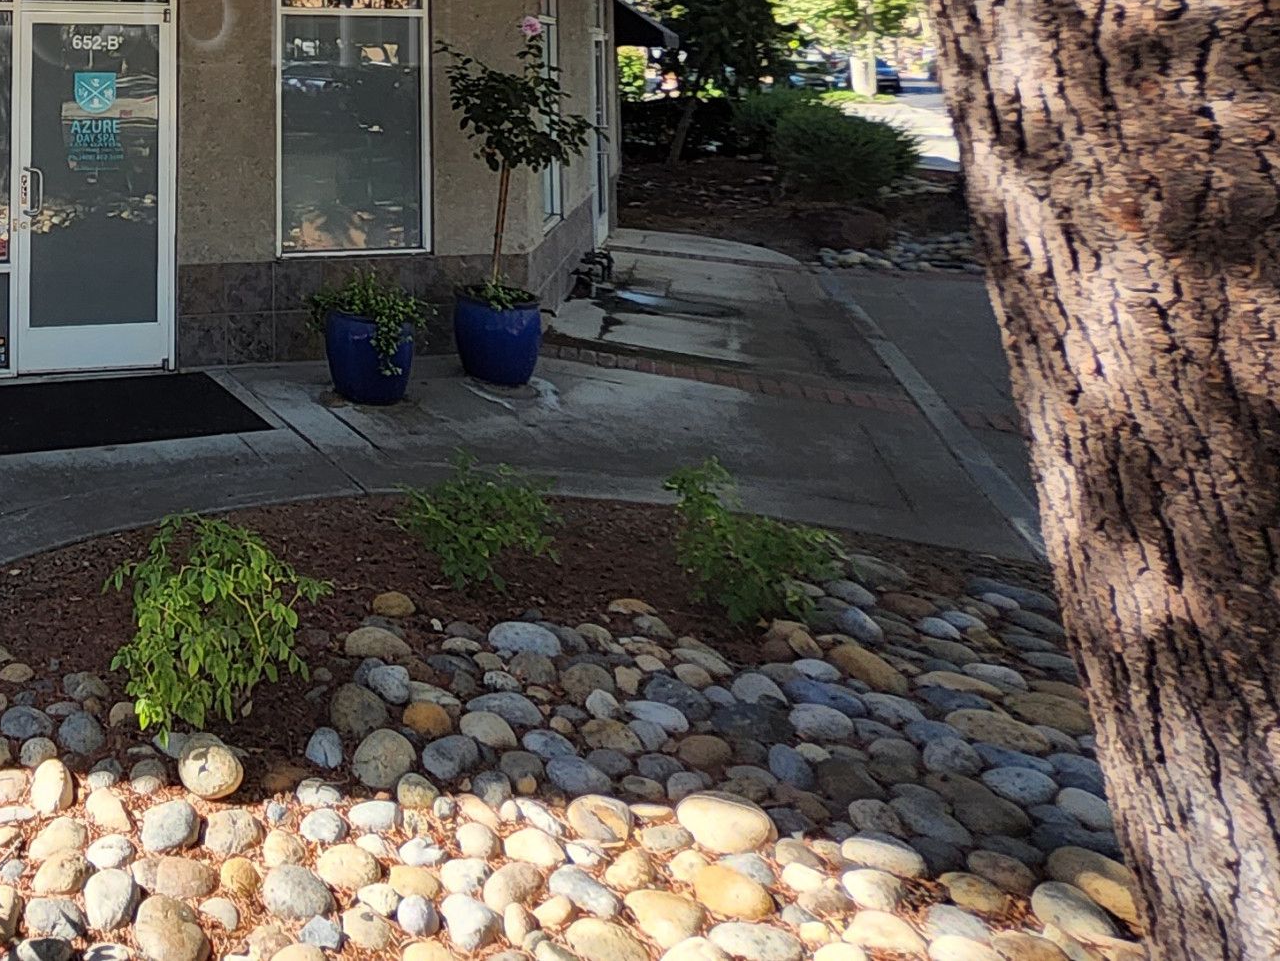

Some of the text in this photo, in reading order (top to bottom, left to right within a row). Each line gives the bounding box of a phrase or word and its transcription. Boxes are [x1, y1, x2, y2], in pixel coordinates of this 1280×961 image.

[72, 35, 120, 50] 652-B
[70, 119, 120, 134] AZURE
[76, 134, 116, 144] DAY SPA
